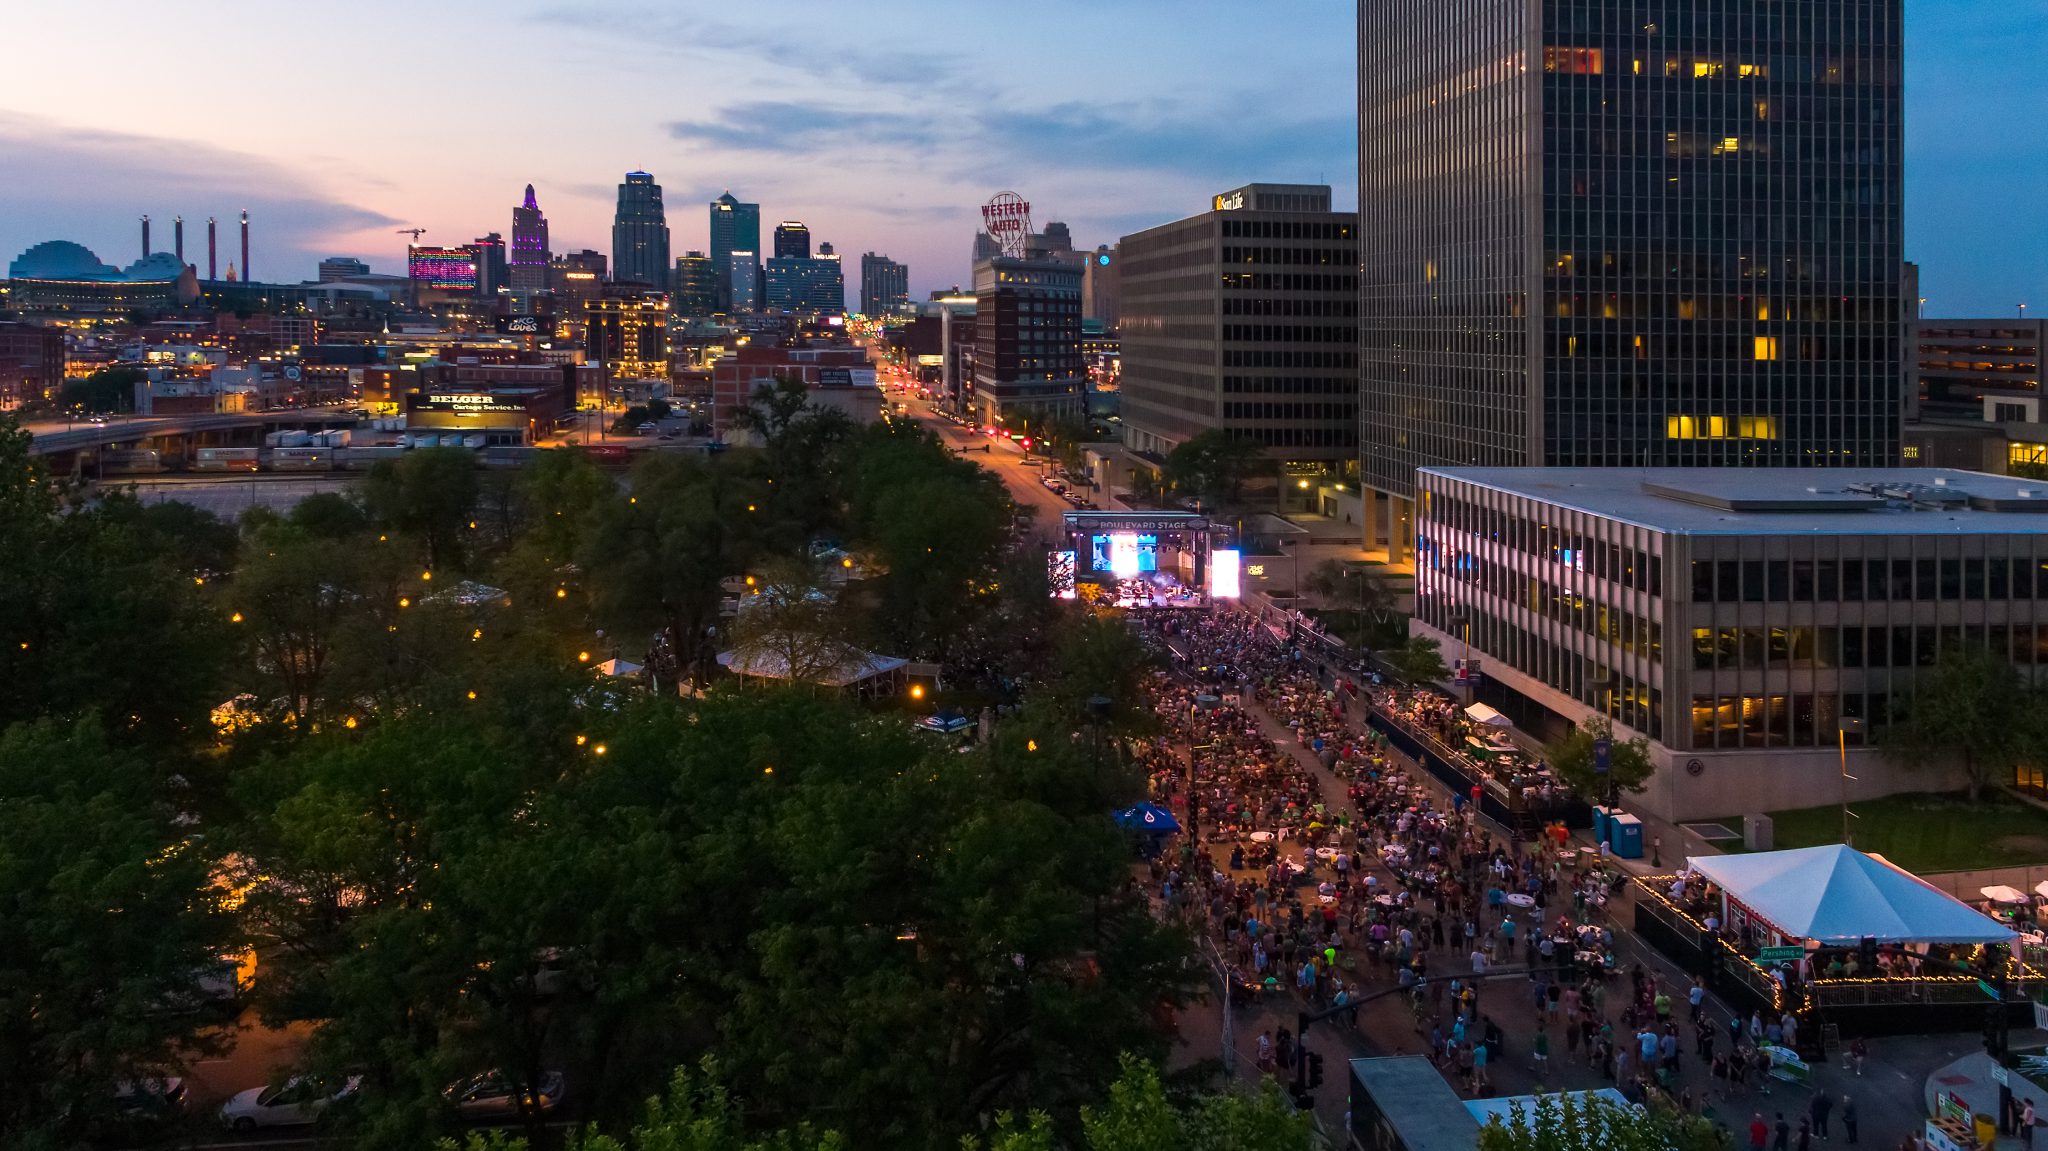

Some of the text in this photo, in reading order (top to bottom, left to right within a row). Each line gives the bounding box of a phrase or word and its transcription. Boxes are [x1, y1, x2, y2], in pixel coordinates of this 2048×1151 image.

[981, 201, 1029, 216] WESTERN
[1222, 192, 1244, 210] Sun Life
[992, 218, 1020, 235] AUTO
[430, 395, 493, 403] BELGER
[1100, 521, 1187, 530] BOULEVARD STAGE
